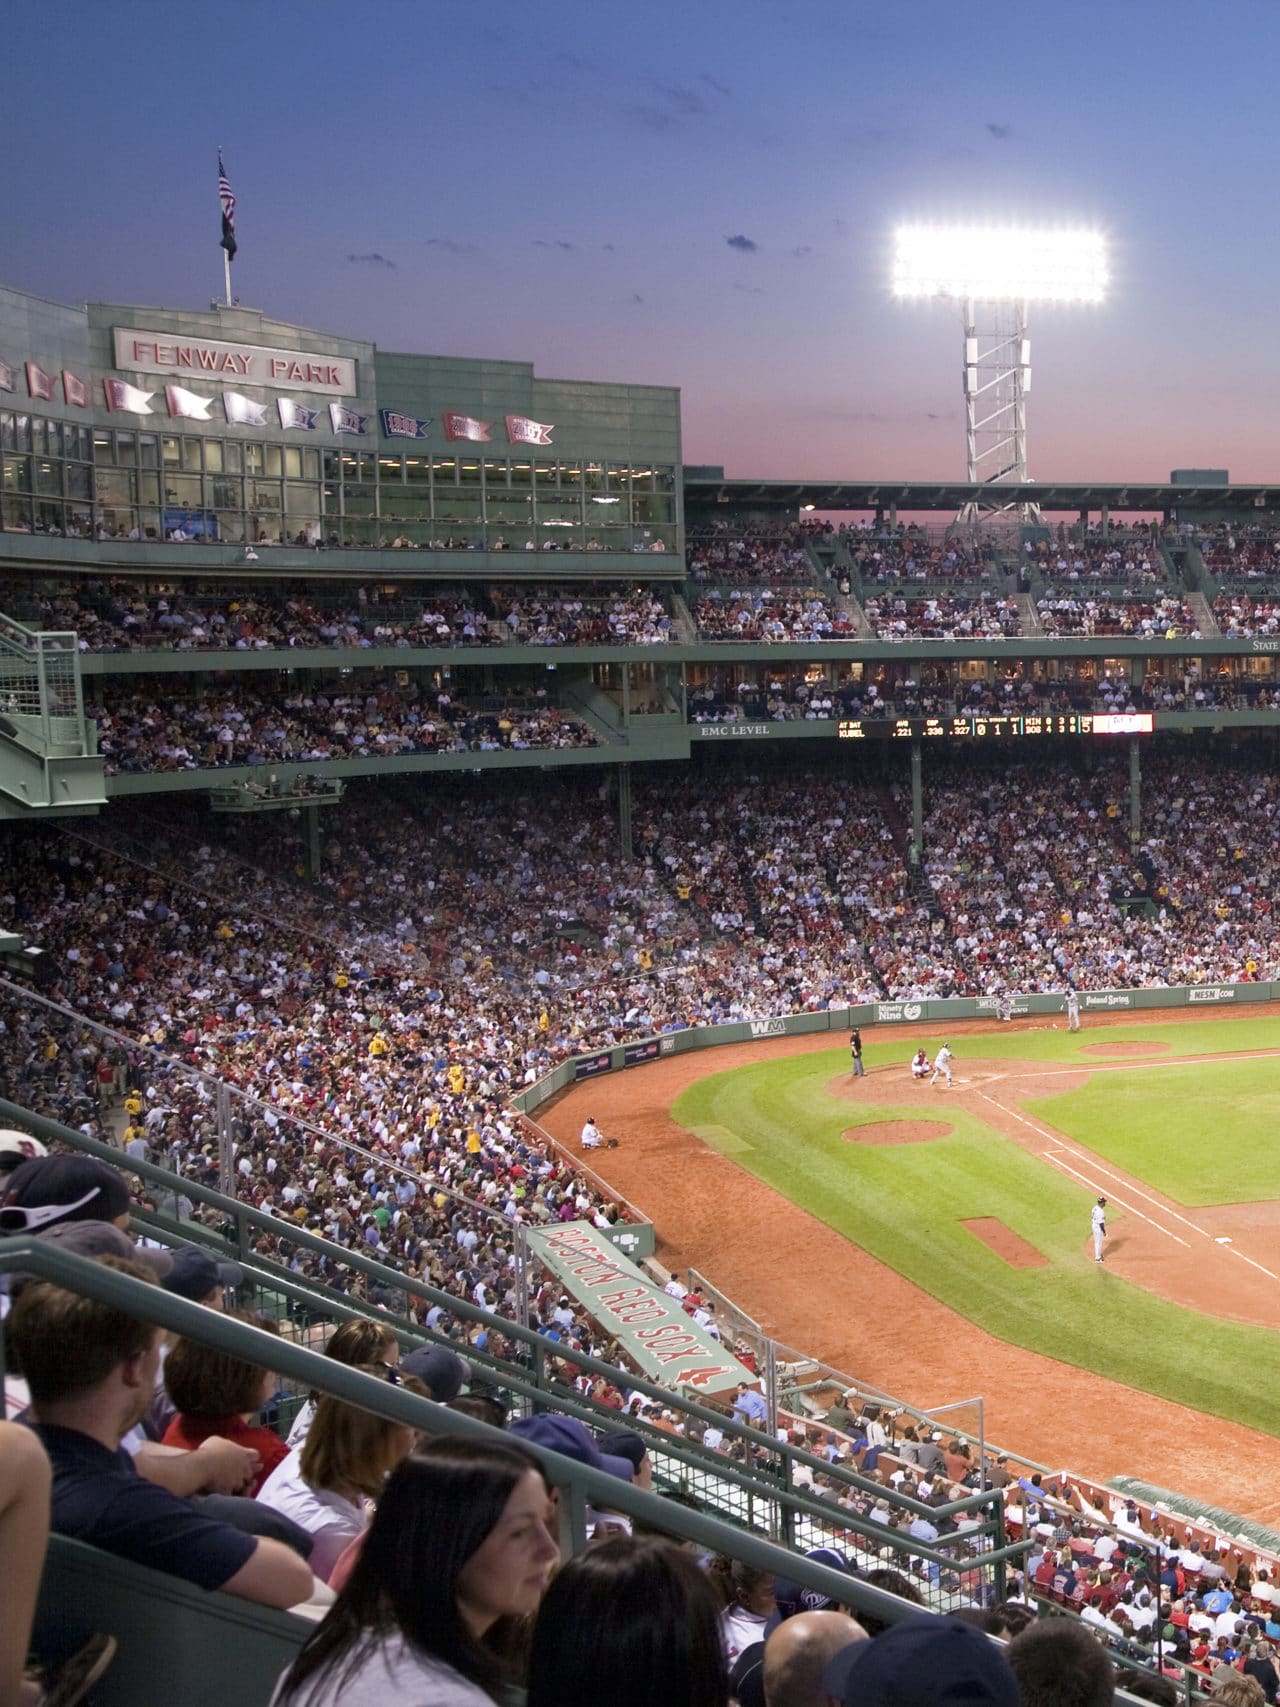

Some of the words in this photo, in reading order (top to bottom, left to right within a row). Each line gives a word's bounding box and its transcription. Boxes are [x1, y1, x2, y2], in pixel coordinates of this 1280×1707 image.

[133, 340, 252, 375] FENWAY
[271, 358, 342, 386] PARK
[1253, 640, 1278, 651] STATE
[1025, 717, 1042, 725] MIN
[701, 726, 728, 737] EMC
[732, 725, 770, 736] LEVEL
[892, 728, 912, 737] .221
[949, 726, 971, 736] .327
[1086, 995, 1108, 1006] Poland
[1108, 994, 1130, 1005] Spring
[878, 1004, 903, 1014] Ninety
[878, 1012, 902, 1021] Nine
[750, 1018, 786, 1034] WM
[544, 1227, 629, 1288] BOSTON
[599, 1287, 670, 1326] RED
[634, 1324, 712, 1365] SOX
